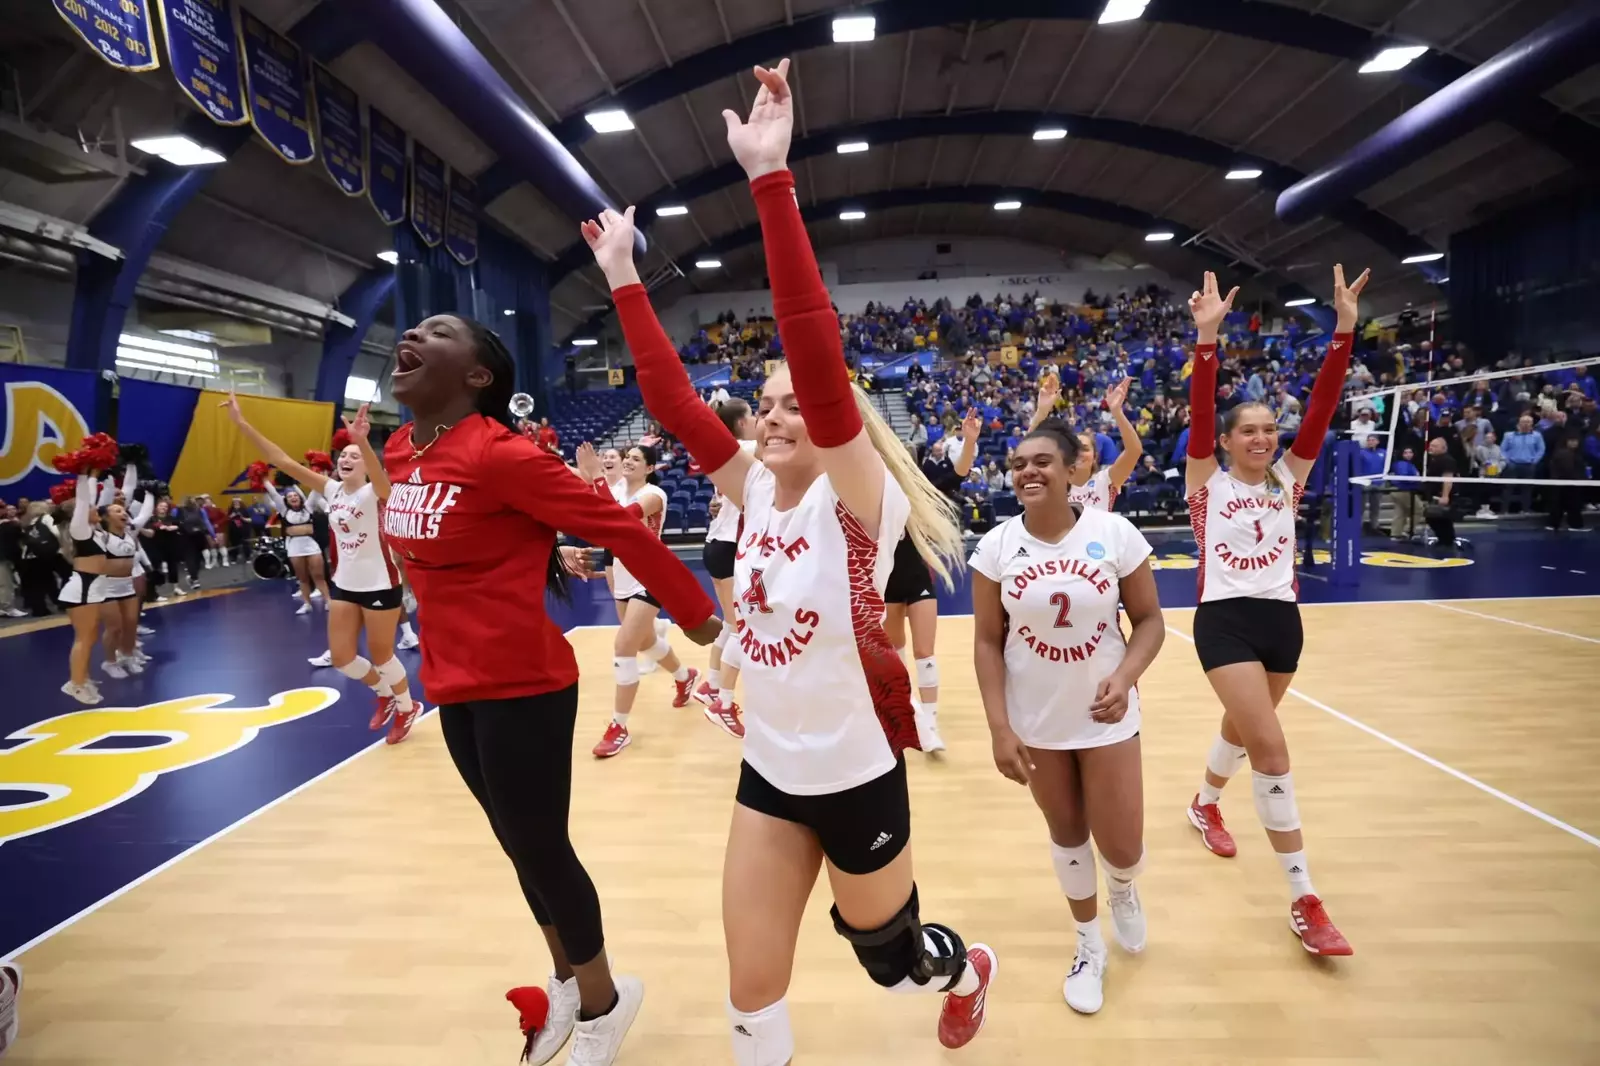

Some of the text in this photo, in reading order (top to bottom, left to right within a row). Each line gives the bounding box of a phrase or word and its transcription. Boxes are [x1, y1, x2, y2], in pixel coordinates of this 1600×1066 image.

[94, 14, 120, 41] 2012
[124, 36, 146, 57] 013
[172, 7, 231, 53] CHAMPIONS
[1006, 351, 1013, 360] C
[612, 371, 620, 379] A
[338, 518, 350, 533] 5
[340, 532, 368, 550] DINALS
[1007, 559, 1111, 601] LOUISVILLE
[1049, 591, 1073, 629] 2
[1018, 621, 1108, 663] CARDINALS
